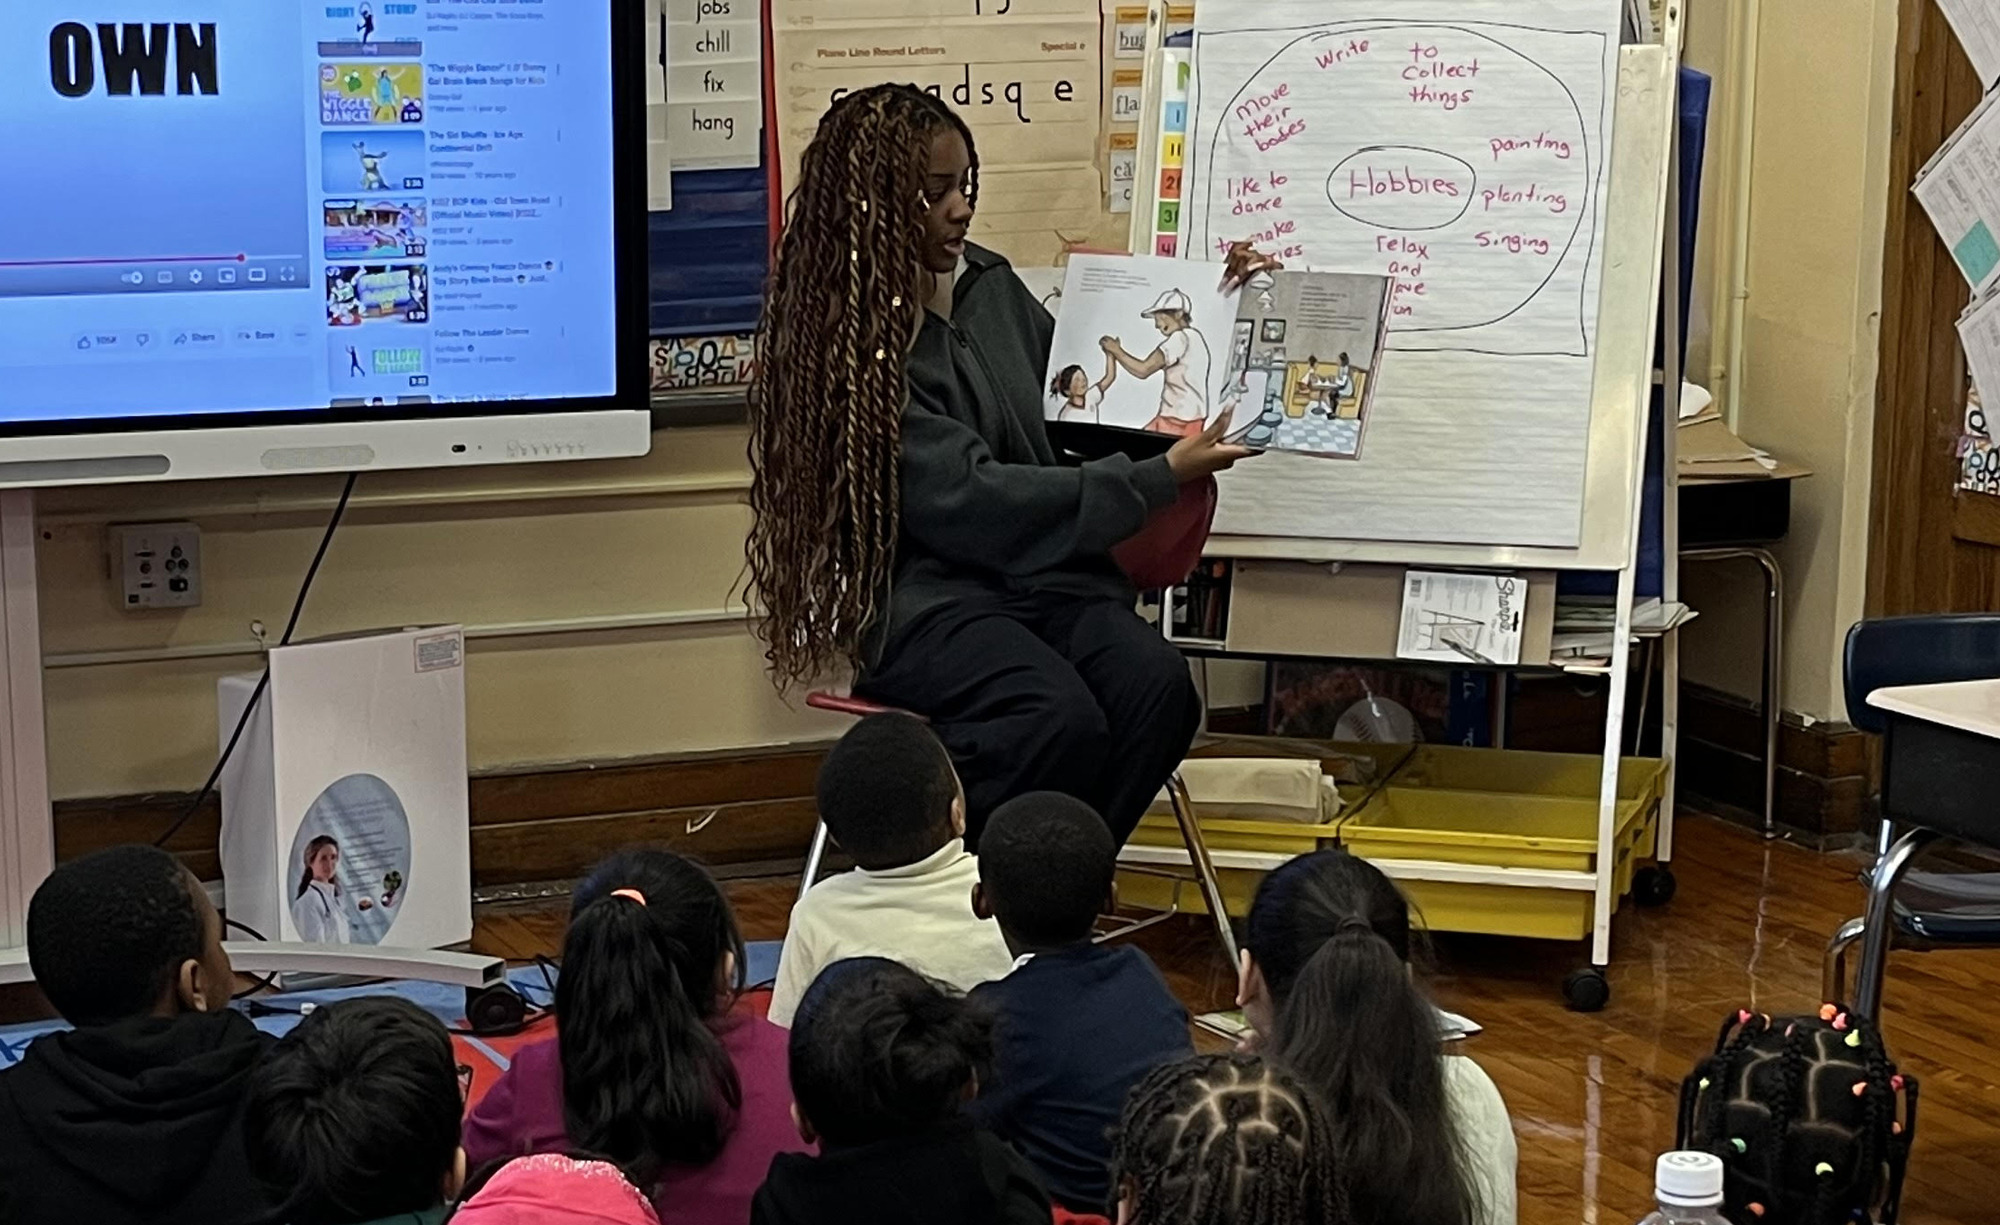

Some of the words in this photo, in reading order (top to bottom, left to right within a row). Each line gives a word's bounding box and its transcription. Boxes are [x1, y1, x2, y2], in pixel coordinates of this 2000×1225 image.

[696, 0, 730, 24] jobs
[696, 29, 730, 52] chill
[849, 48, 870, 57] Line
[873, 47, 905, 56] Round
[908, 46, 946, 55] Letters
[1409, 42, 1438, 63] to
[48, 21, 219, 97] OWN
[1315, 40, 1369, 69] Write
[704, 70, 724, 92] fix
[1409, 84, 1474, 111] things
[692, 108, 734, 140] hang
[1243, 106, 1291, 136] their
[1490, 132, 1570, 161] painting
[1228, 177, 1260, 199] like
[1270, 171, 1287, 188] to
[1351, 166, 1459, 199] Hobbies
[1232, 196, 1282, 215] dance
[1482, 184, 1566, 213] planting
[1377, 235, 1429, 260] relax
[1388, 261, 1421, 277] and
